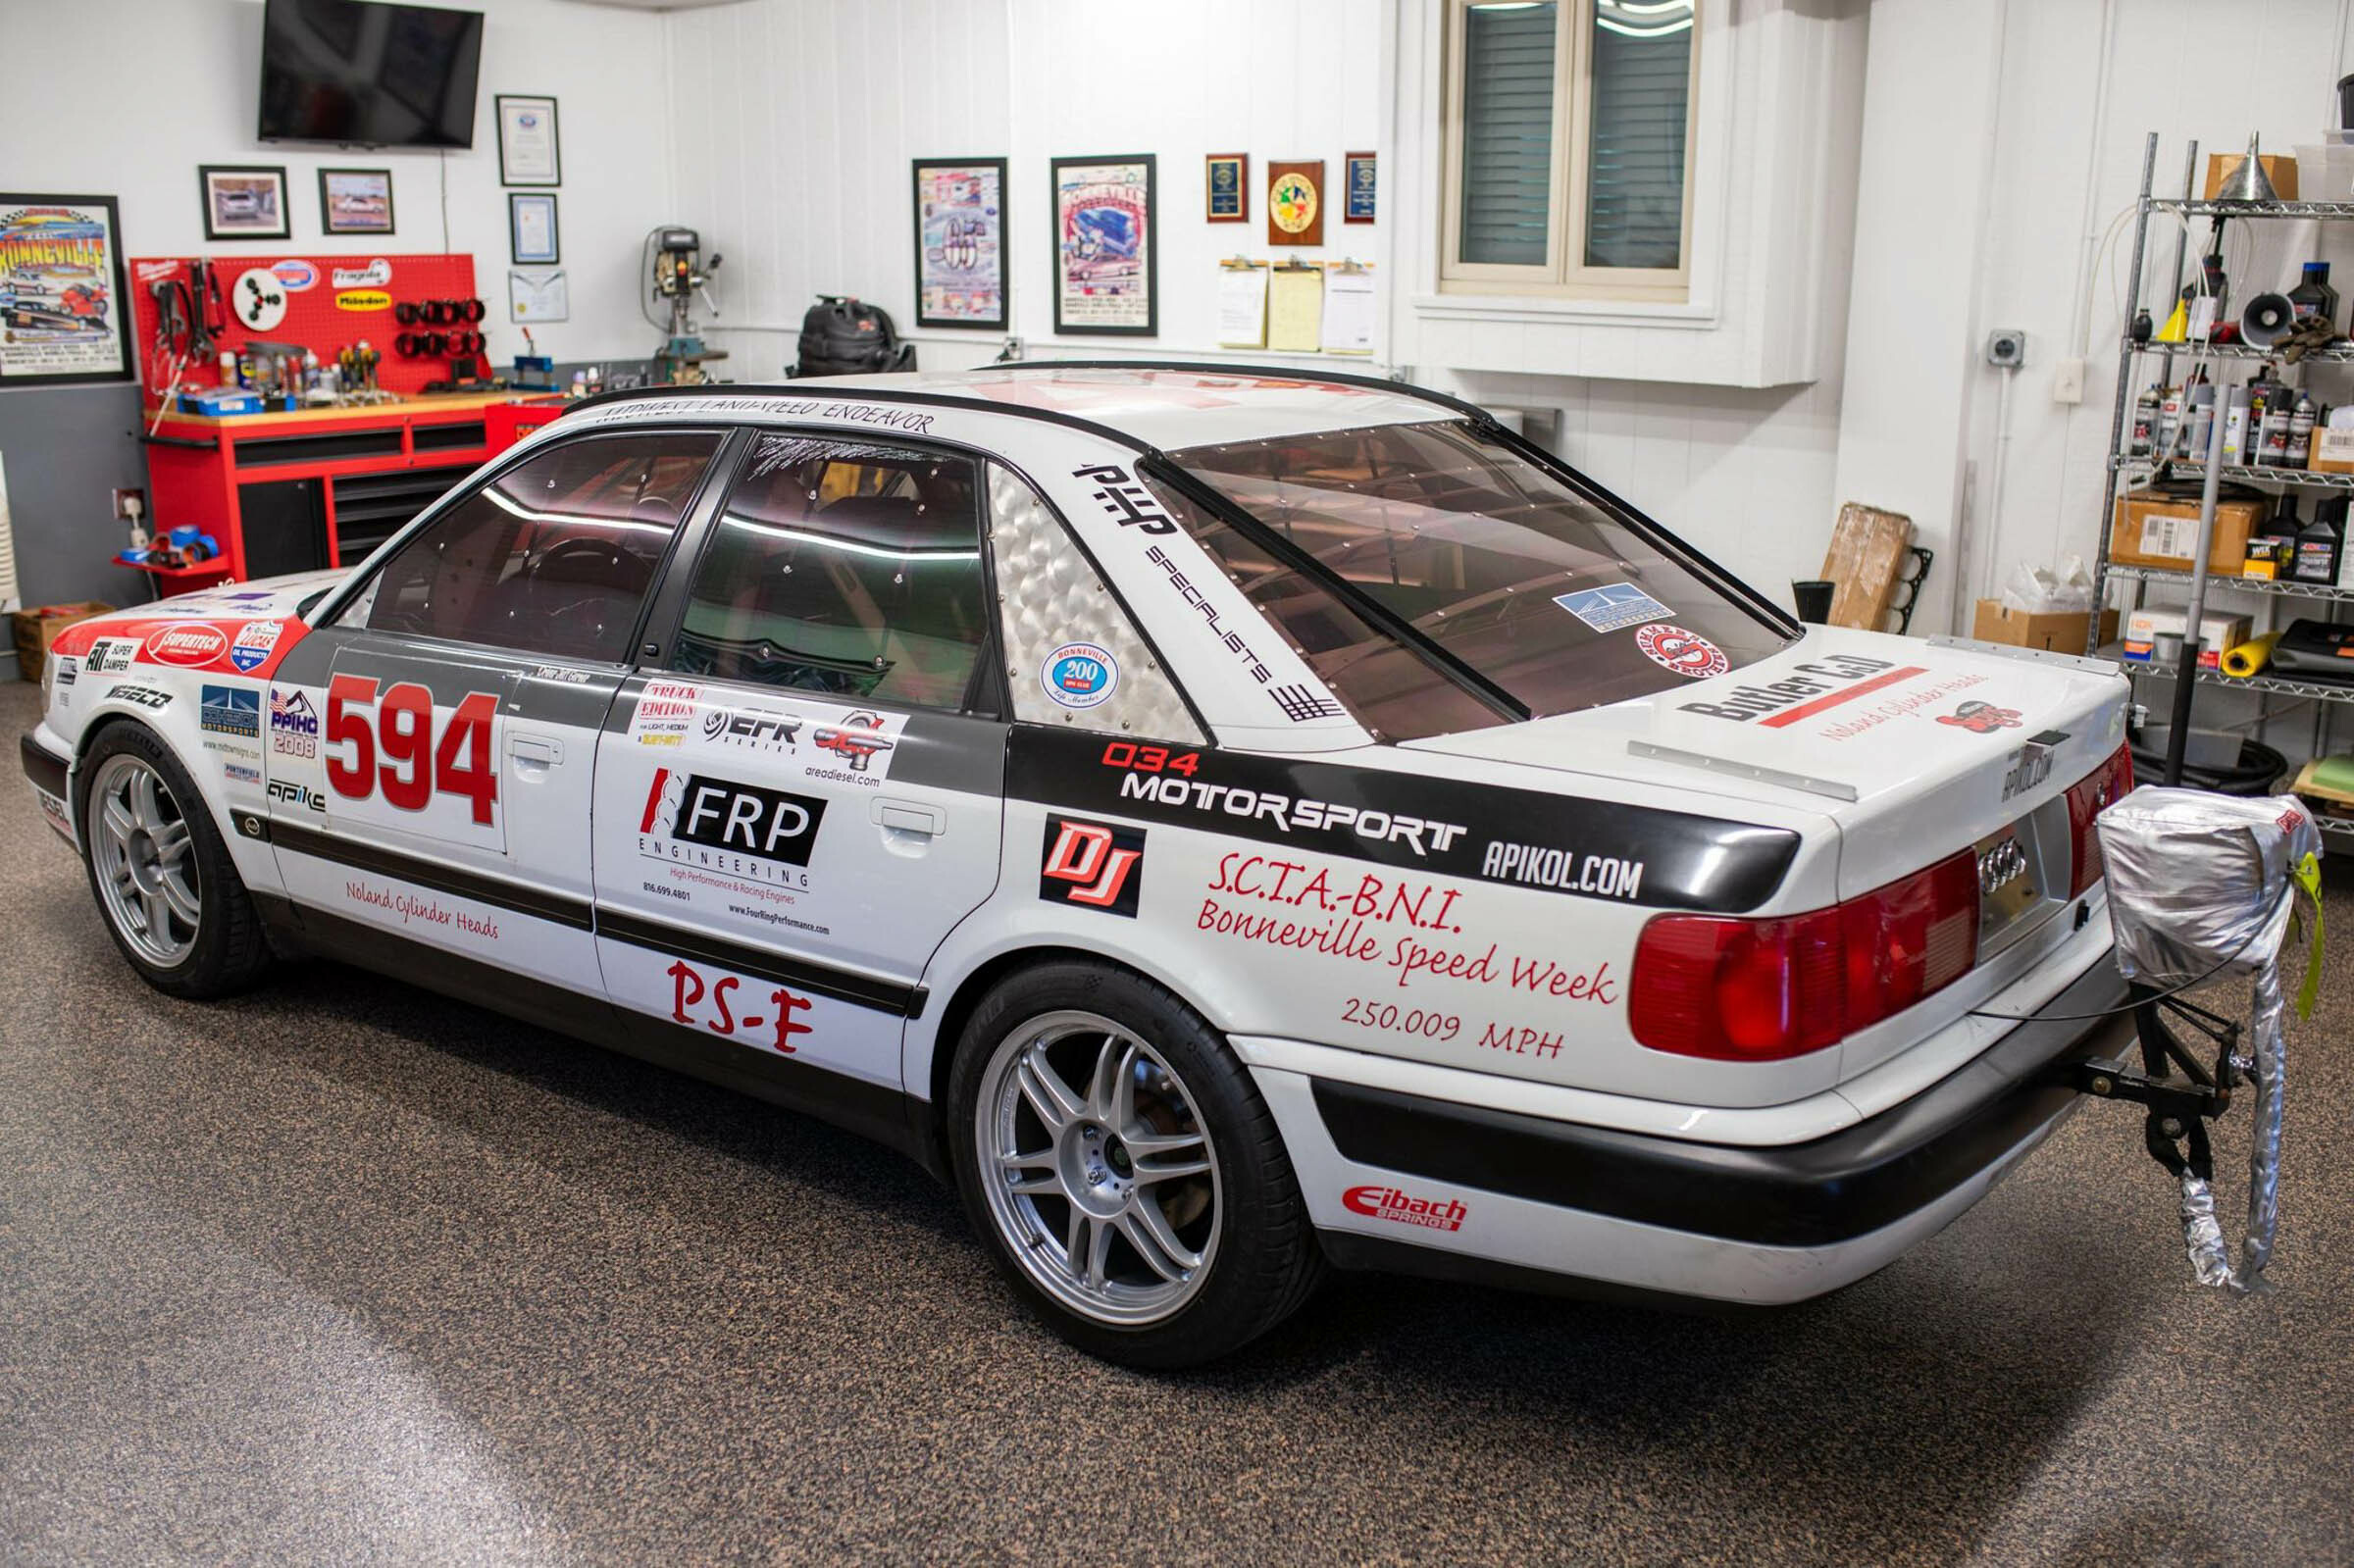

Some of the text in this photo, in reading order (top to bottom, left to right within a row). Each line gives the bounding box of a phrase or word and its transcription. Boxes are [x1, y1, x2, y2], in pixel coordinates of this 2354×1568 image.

[823, 403, 934, 434] ENDEAVOR
[1146, 545, 1273, 683] SPECIALISTS
[112, 644, 133, 656] SUPER
[1057, 647, 1109, 666] BONNEVILLE
[1639, 625, 1701, 656] SUMMERS
[103, 659, 129, 672] DAMPER
[1063, 659, 1099, 681] 200
[1667, 646, 1727, 679] BROTHERS
[640, 700, 694, 718] EDITION
[651, 686, 697, 700] TRUCK
[1676, 674, 1834, 722] Butler
[1818, 710, 1885, 742] Noland
[1876, 689, 1945, 719] Cylinder
[274, 734, 316, 759] 2008
[325, 672, 501, 829] 594
[723, 735, 797, 756] SERIES
[1101, 742, 1200, 778] 034
[804, 765, 881, 788] areadiesel.com
[686, 785, 810, 853] FRP
[1121, 772, 1468, 856] MOTORSPORT
[639, 836, 809, 887] ENGINEERING
[1043, 821, 1143, 906] DJ
[1482, 840, 1644, 899] APIKOL.COM
[642, 882, 691, 902] 816.699.4801
[669, 867, 795, 906] High Performance & Racing Engines
[1208, 852, 1463, 934] S.C.T.A.-B.N.I.
[345, 882, 499, 940] Noland Cylinder Heads
[728, 904, 831, 936] www.FourRingPerformance.com
[1198, 898, 1619, 1005] Bonneville Speed Week
[1341, 997, 1566, 1060] 250.009 MPH
[1342, 1185, 1468, 1221] Eibach
[1376, 1207, 1454, 1231] SPRINGS
